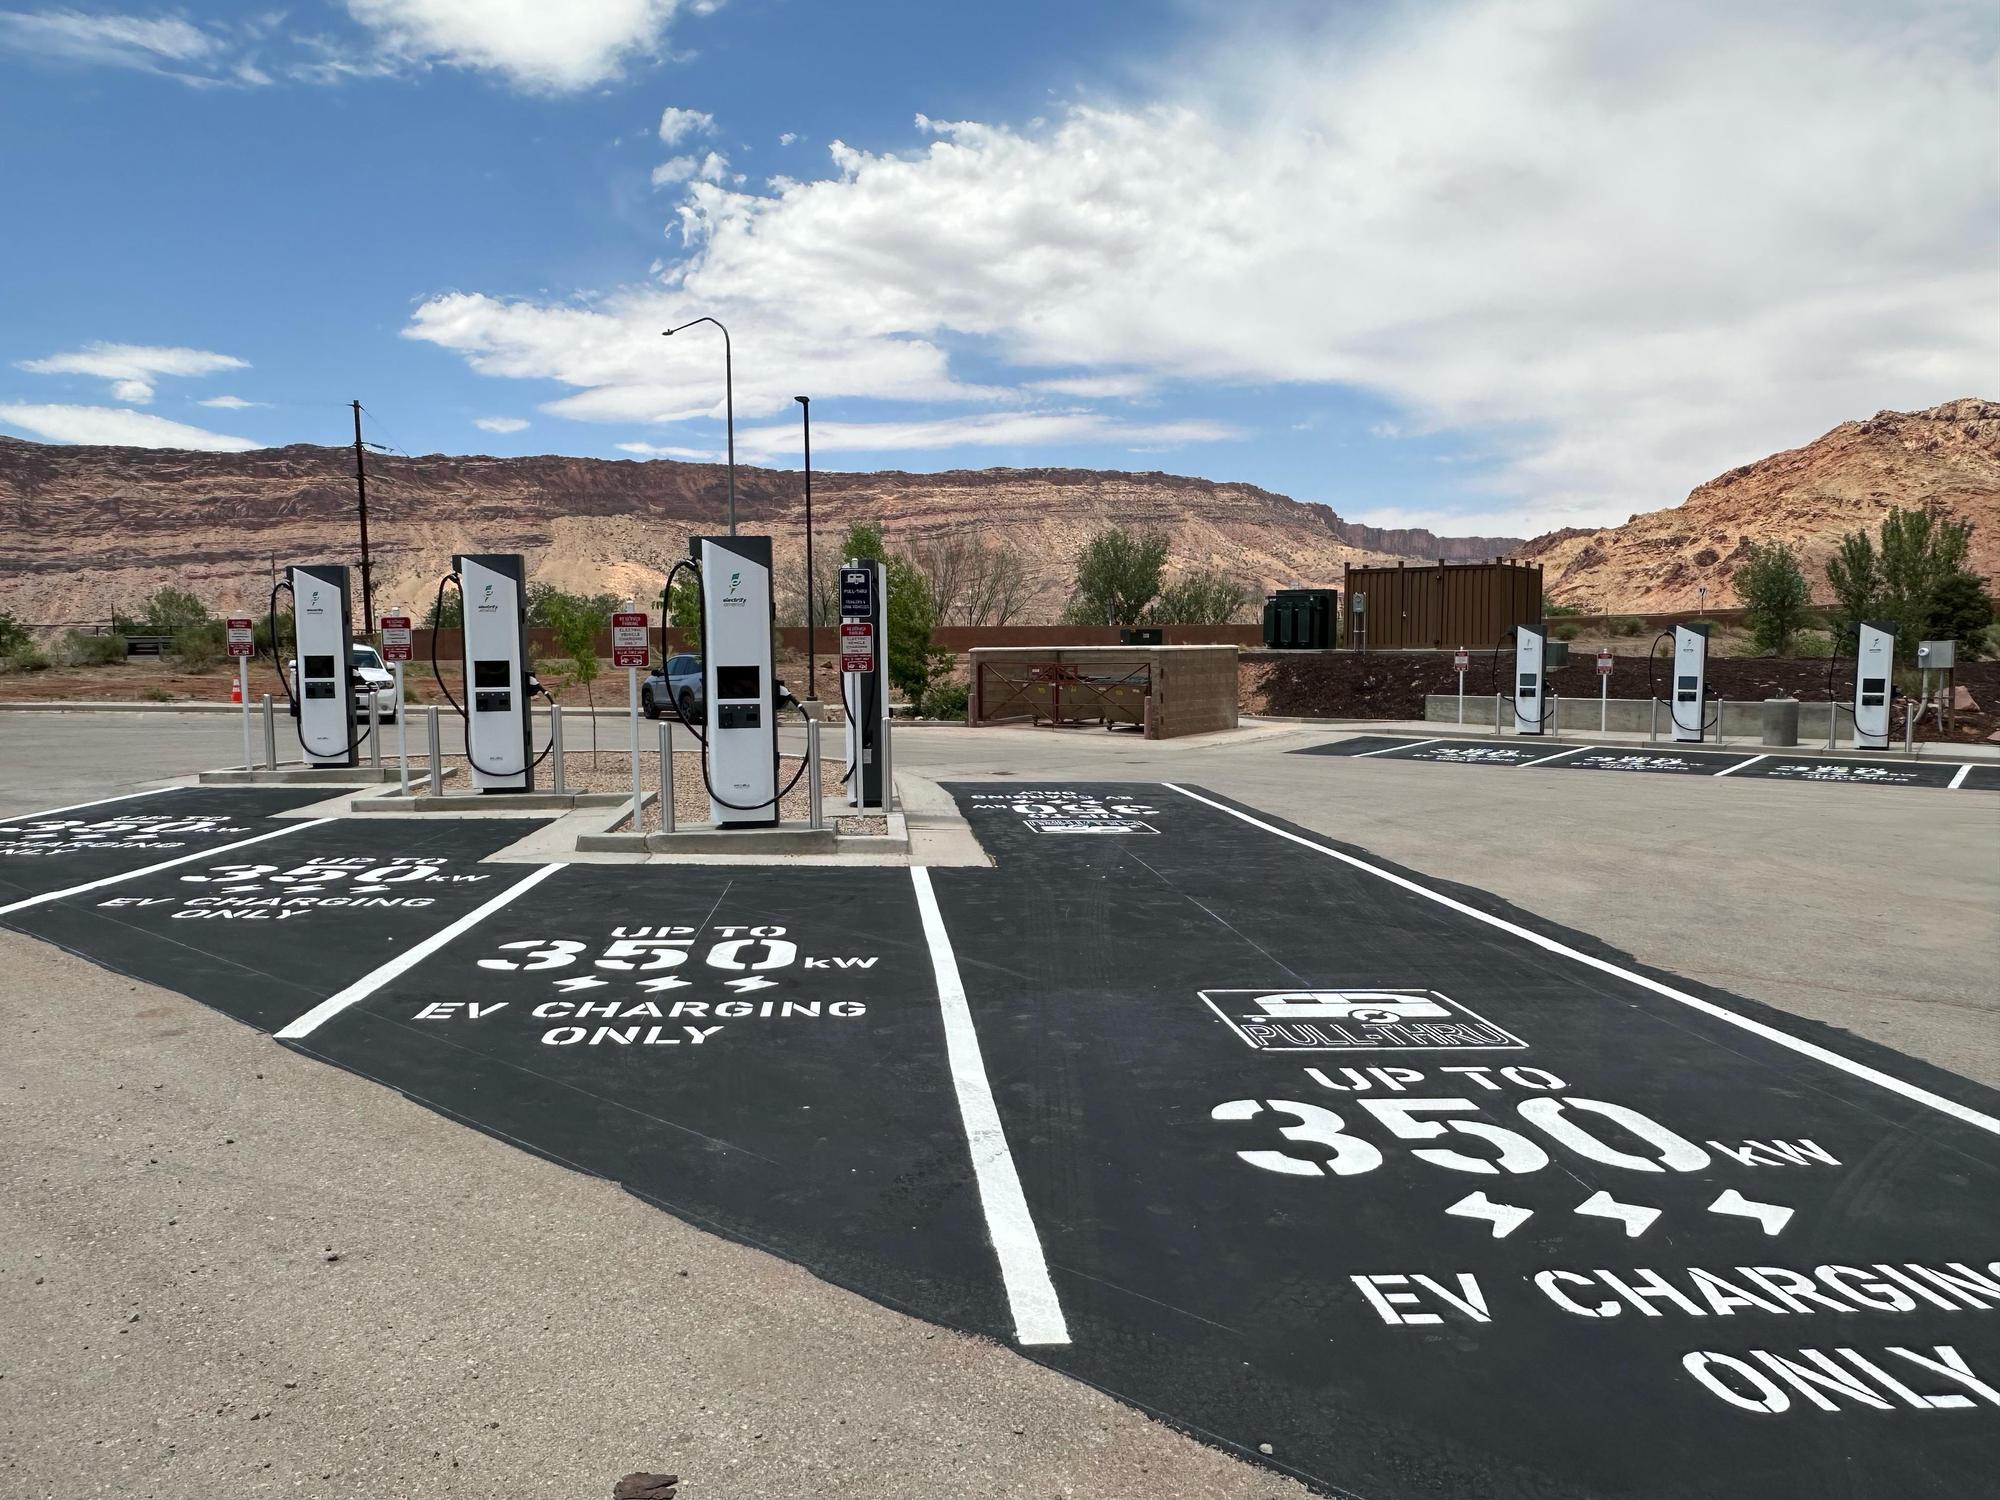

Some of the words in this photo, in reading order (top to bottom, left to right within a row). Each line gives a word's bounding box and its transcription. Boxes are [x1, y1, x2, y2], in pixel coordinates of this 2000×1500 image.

[1011, 804, 1160, 815] 350
[0, 820, 217, 833] 350
[306, 857, 377, 865] UP
[391, 857, 449, 865] TO
[180, 865, 440, 883] 350
[425, 874, 491, 882] kW
[97, 897, 176, 907] EV
[183, 897, 436, 907] CHARGING
[171, 909, 313, 919] ONLY
[610, 926, 695, 938] UP
[713, 926, 787, 937] TO
[477, 939, 798, 971] 350
[803, 956, 879, 969] kW
[411, 1002, 510, 1020] EV
[531, 1001, 867, 1018] CHARGING
[540, 1026, 725, 1045] ONLY
[1240, 1023, 1511, 1047] PULL-THRU
[1303, 1067, 1425, 1091] UP
[1439, 1066, 1570, 1091] TO
[1210, 1096, 1712, 1176] 350
[1705, 1138, 1843, 1167] kW
[1350, 1273, 1493, 1325] EV
[1682, 1345, 2000, 1414] ONLY
